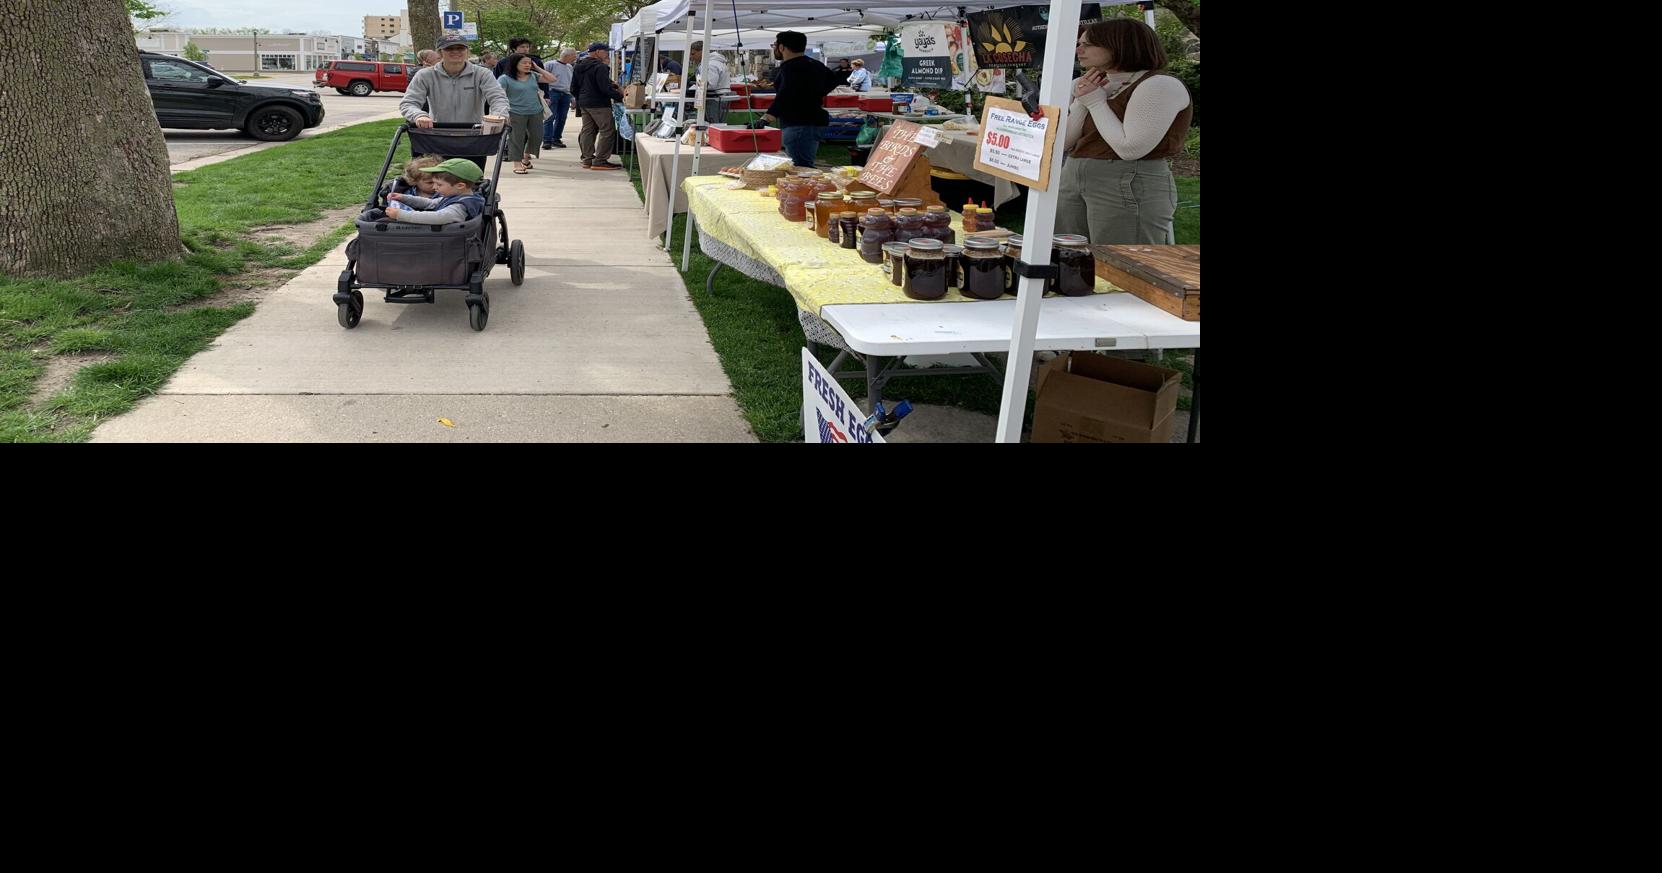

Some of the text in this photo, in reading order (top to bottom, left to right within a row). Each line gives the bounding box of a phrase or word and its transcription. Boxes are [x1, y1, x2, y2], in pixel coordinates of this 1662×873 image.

[446, 14, 460, 25] P
[993, 51, 1032, 63] COSECHA
[990, 113, 1004, 121] FREE
[1006, 116, 1026, 126] RANGE
[1028, 121, 1045, 130] EGGS
[986, 131, 1010, 149] $5.00
[880, 141, 912, 157] BIRDS
[871, 162, 898, 177] THE
[863, 171, 892, 189] BEES
[808, 360, 845, 425] FRESH
